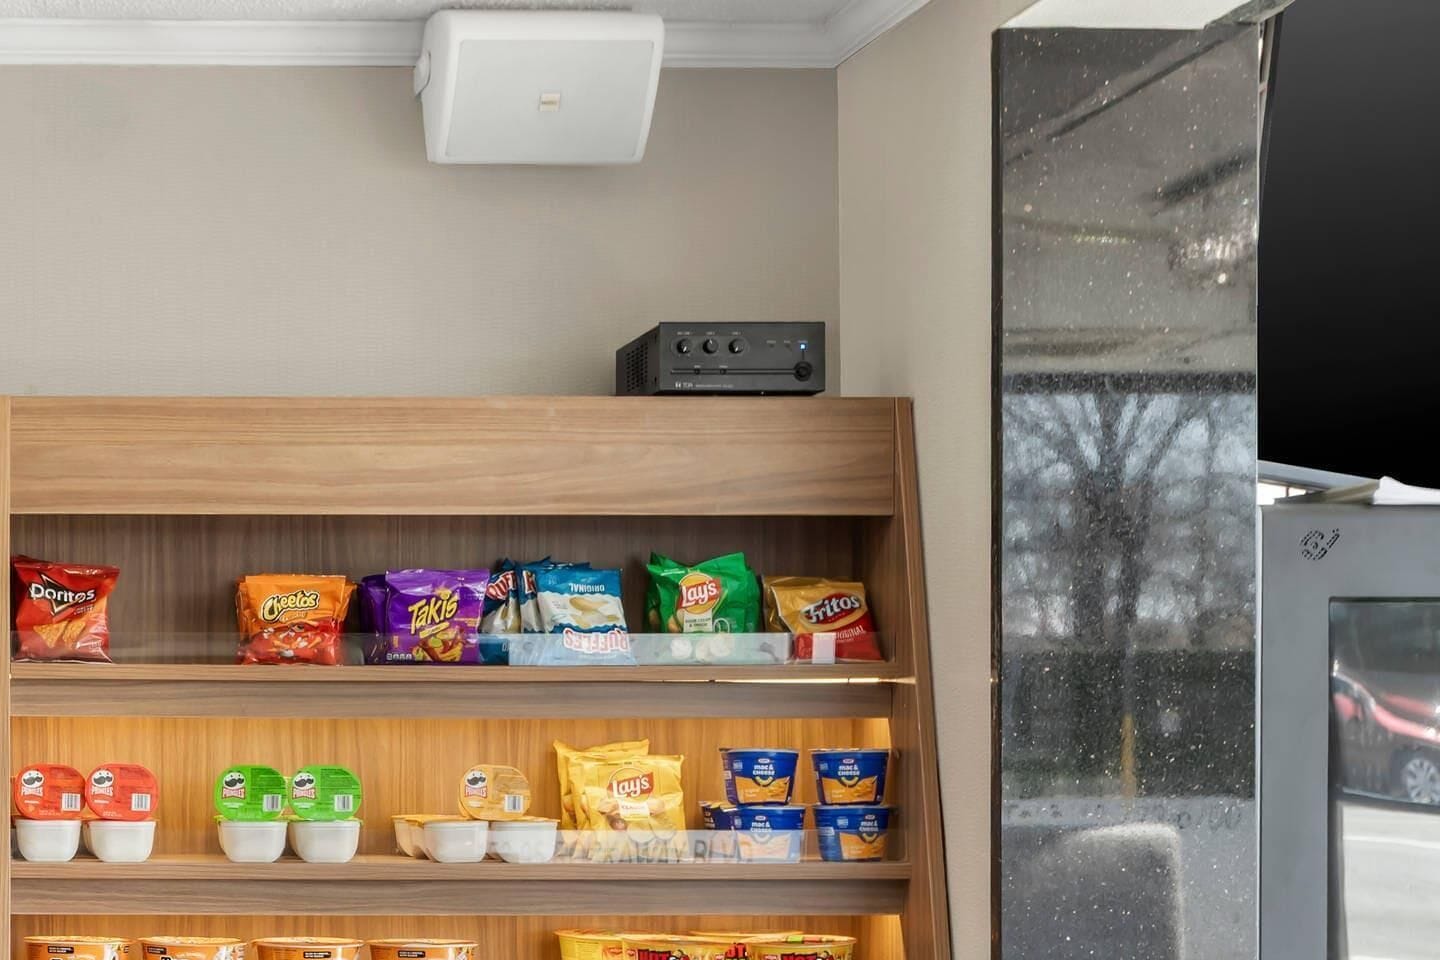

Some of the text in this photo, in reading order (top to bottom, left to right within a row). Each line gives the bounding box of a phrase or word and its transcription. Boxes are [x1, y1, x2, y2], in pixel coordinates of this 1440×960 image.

[29, 583, 95, 603] Doritos
[262, 590, 319, 622] Cheetos
[681, 581, 718, 607] Lay's
[408, 593, 458, 634] Takis
[801, 595, 861, 624] Fritos
[613, 775, 650, 798] Lay's
